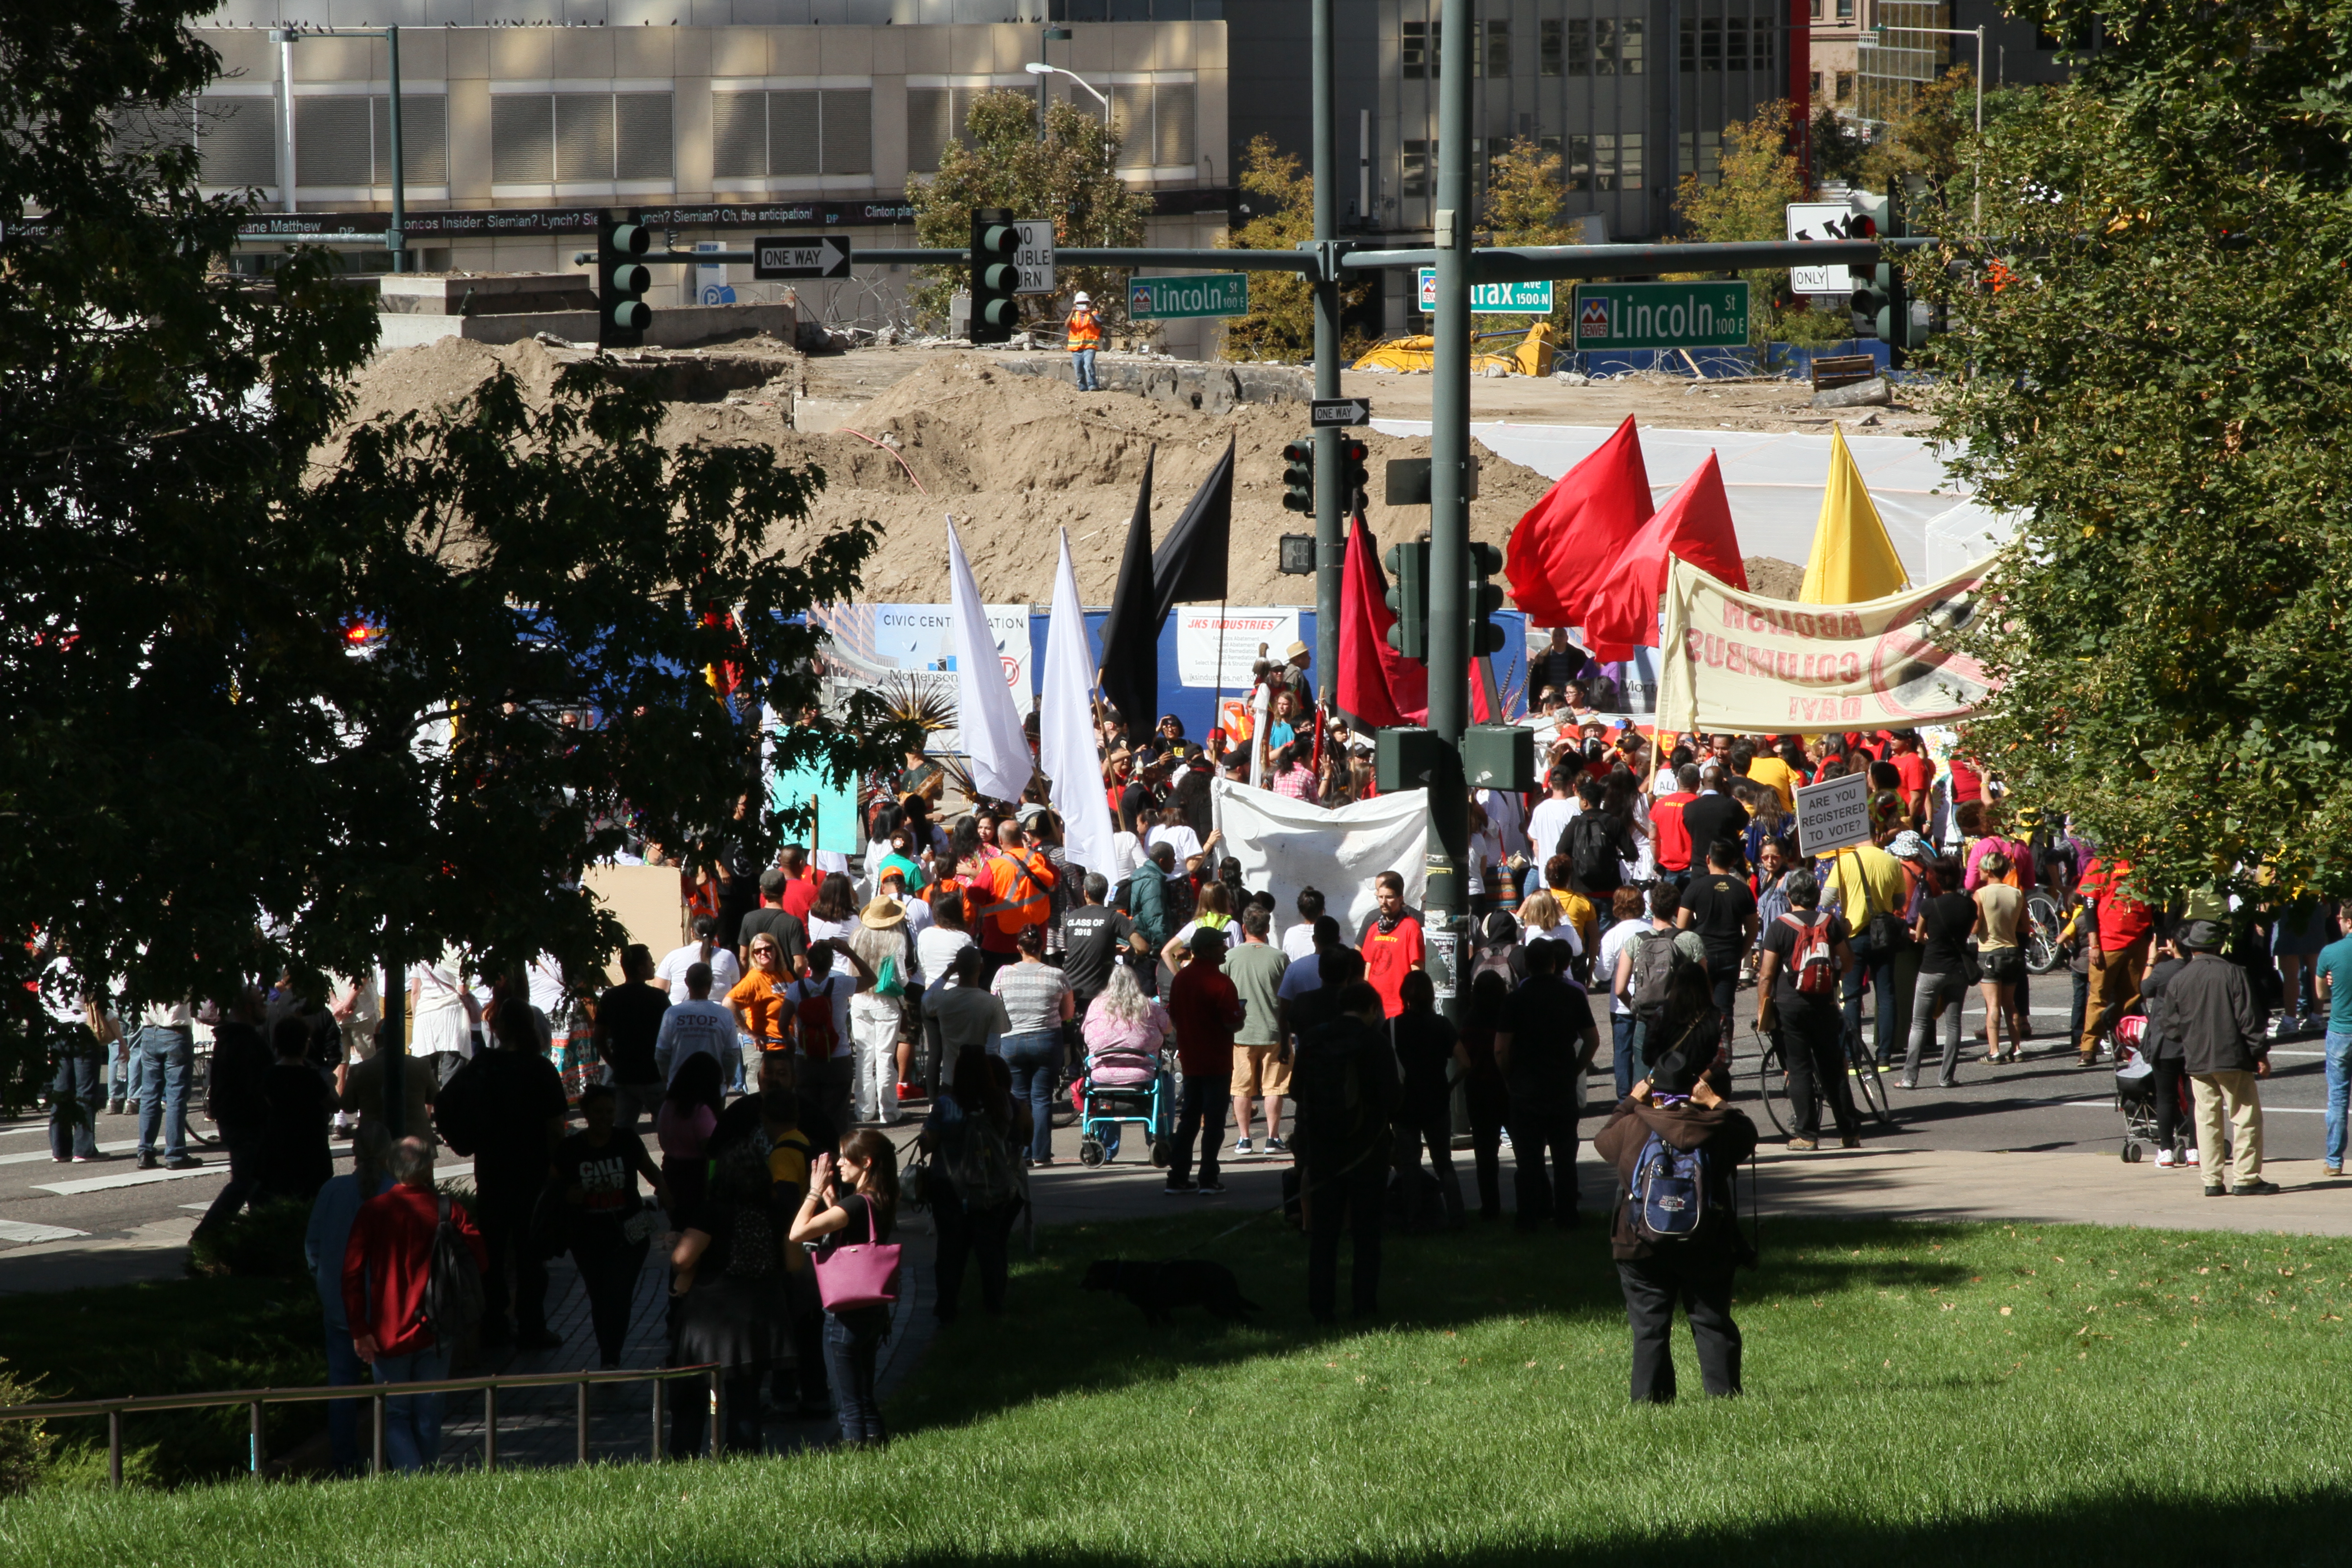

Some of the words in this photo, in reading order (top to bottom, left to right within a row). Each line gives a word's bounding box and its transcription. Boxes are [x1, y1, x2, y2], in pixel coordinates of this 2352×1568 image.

[640, 211, 670, 226] ynch?
[674, 210, 720, 223] Siemian?
[722, 209, 739, 223] Oh,
[741, 209, 757, 220] the
[759, 208, 813, 223] anticipation!
[865, 205, 896, 217] Clinton
[271, 220, 321, 232] Matthew
[404, 218, 438, 229] oncos
[443, 216, 484, 229] Insider:
[488, 214, 538, 228] Siemian?
[542, 213, 579, 230] Lynch?
[765, 250, 789, 265] ONE
[795, 250, 821, 265] WAY
[1016, 250, 1049, 266] UBLE
[1017, 271, 1041, 288] URN
[1797, 271, 1825, 284] ONLY
[1154, 282, 1221, 312] Lincoln
[1230, 282, 1237, 293] St
[1471, 283, 1513, 305] lfax
[1223, 298, 1237, 308] 100
[1240, 297, 1244, 307] E
[1613, 294, 1713, 338] Lincoln
[1725, 294, 1735, 311] St
[1581, 324, 1607, 337] DENVER
[1716, 318, 1735, 334] 100
[1739, 318, 1744, 333] E
[1317, 408, 1333, 419] ONE
[1336, 407, 1352, 417] WAY
[884, 615, 915, 627] CIVIC
[920, 616, 951, 628] CENT
[988, 618, 1024, 629] ATION
[1188, 619, 1208, 629] JKS
[1211, 620, 1274, 630] INDUSTRIES
[889, 669, 958, 682] Mortenson
[1660, 781, 1676, 791] ALL
[1809, 796, 1830, 810] ARE
[1835, 789, 1856, 803] YOU
[1802, 803, 1865, 828] REGISTERED
[1809, 830, 1823, 841] TO
[1829, 820, 1861, 837] VOTE?
[1067, 918, 1092, 926] CLASS
[676, 1014, 718, 1026] STOP
